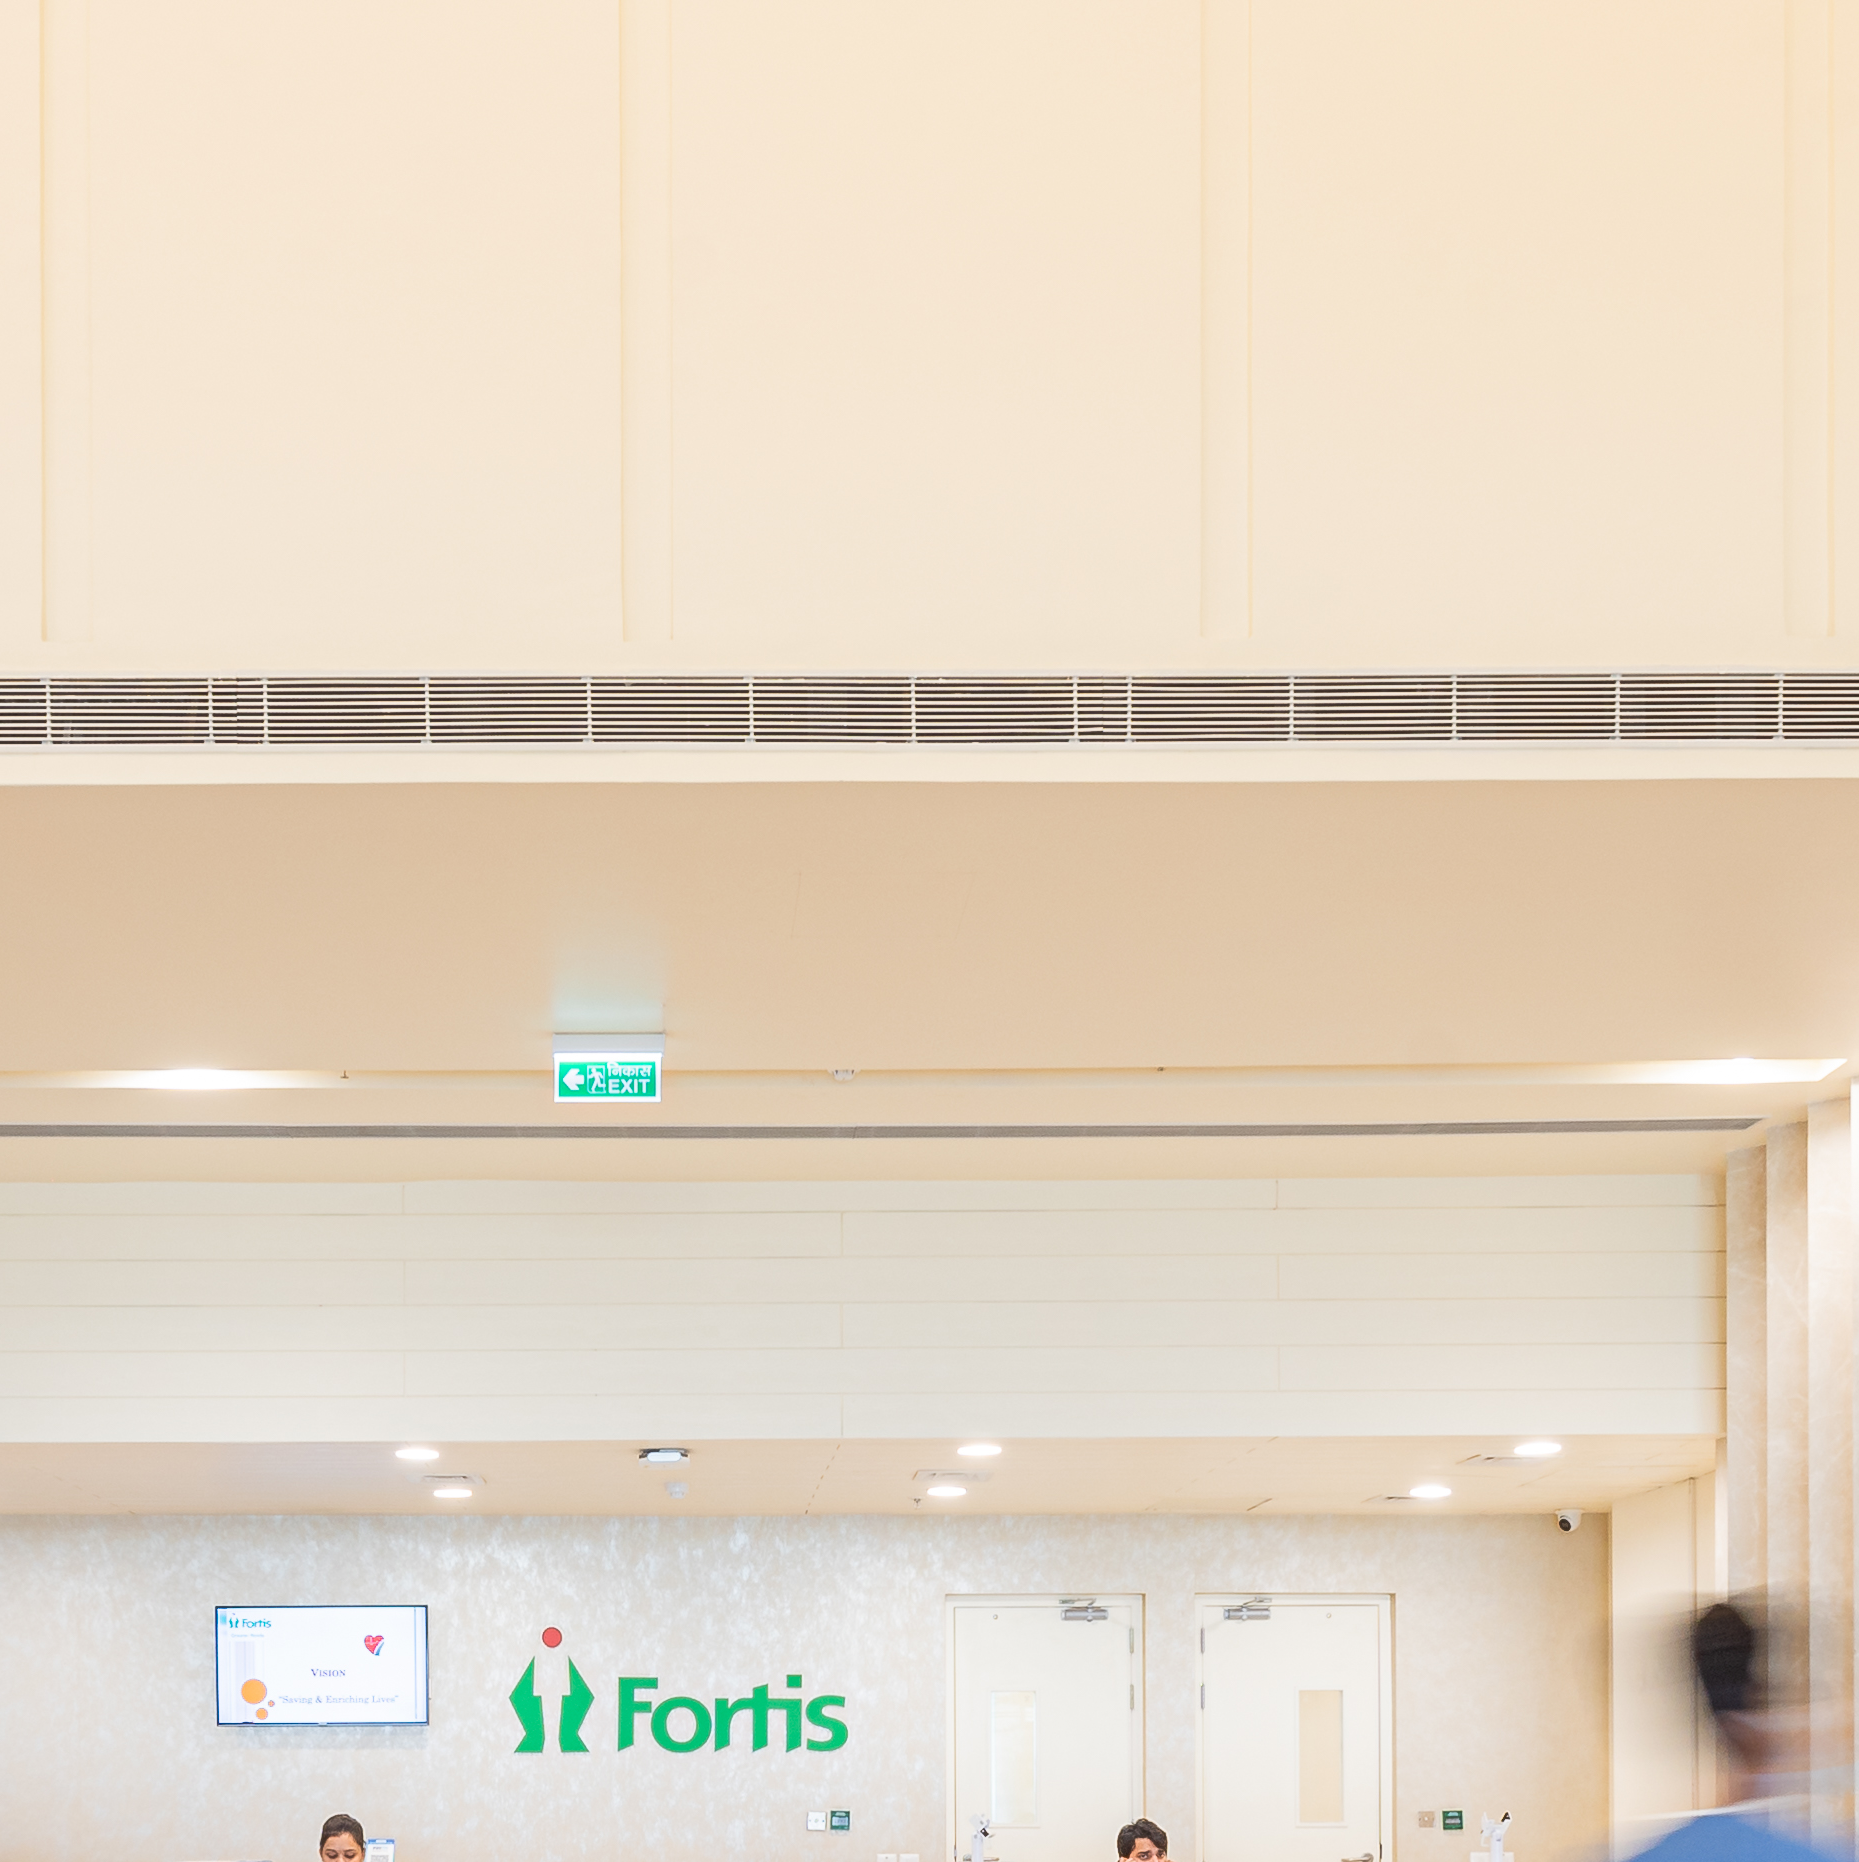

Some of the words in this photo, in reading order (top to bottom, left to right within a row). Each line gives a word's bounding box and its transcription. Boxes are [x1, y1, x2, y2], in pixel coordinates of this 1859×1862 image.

[607, 1061, 652, 1077] निकास
[608, 1079, 650, 1093] EXIT
[242, 1618, 272, 1628] Fortis
[315, 1696, 322, 1704] &
[325, 1696, 369, 1705] Enriching
[618, 1674, 849, 1753] Fortis
